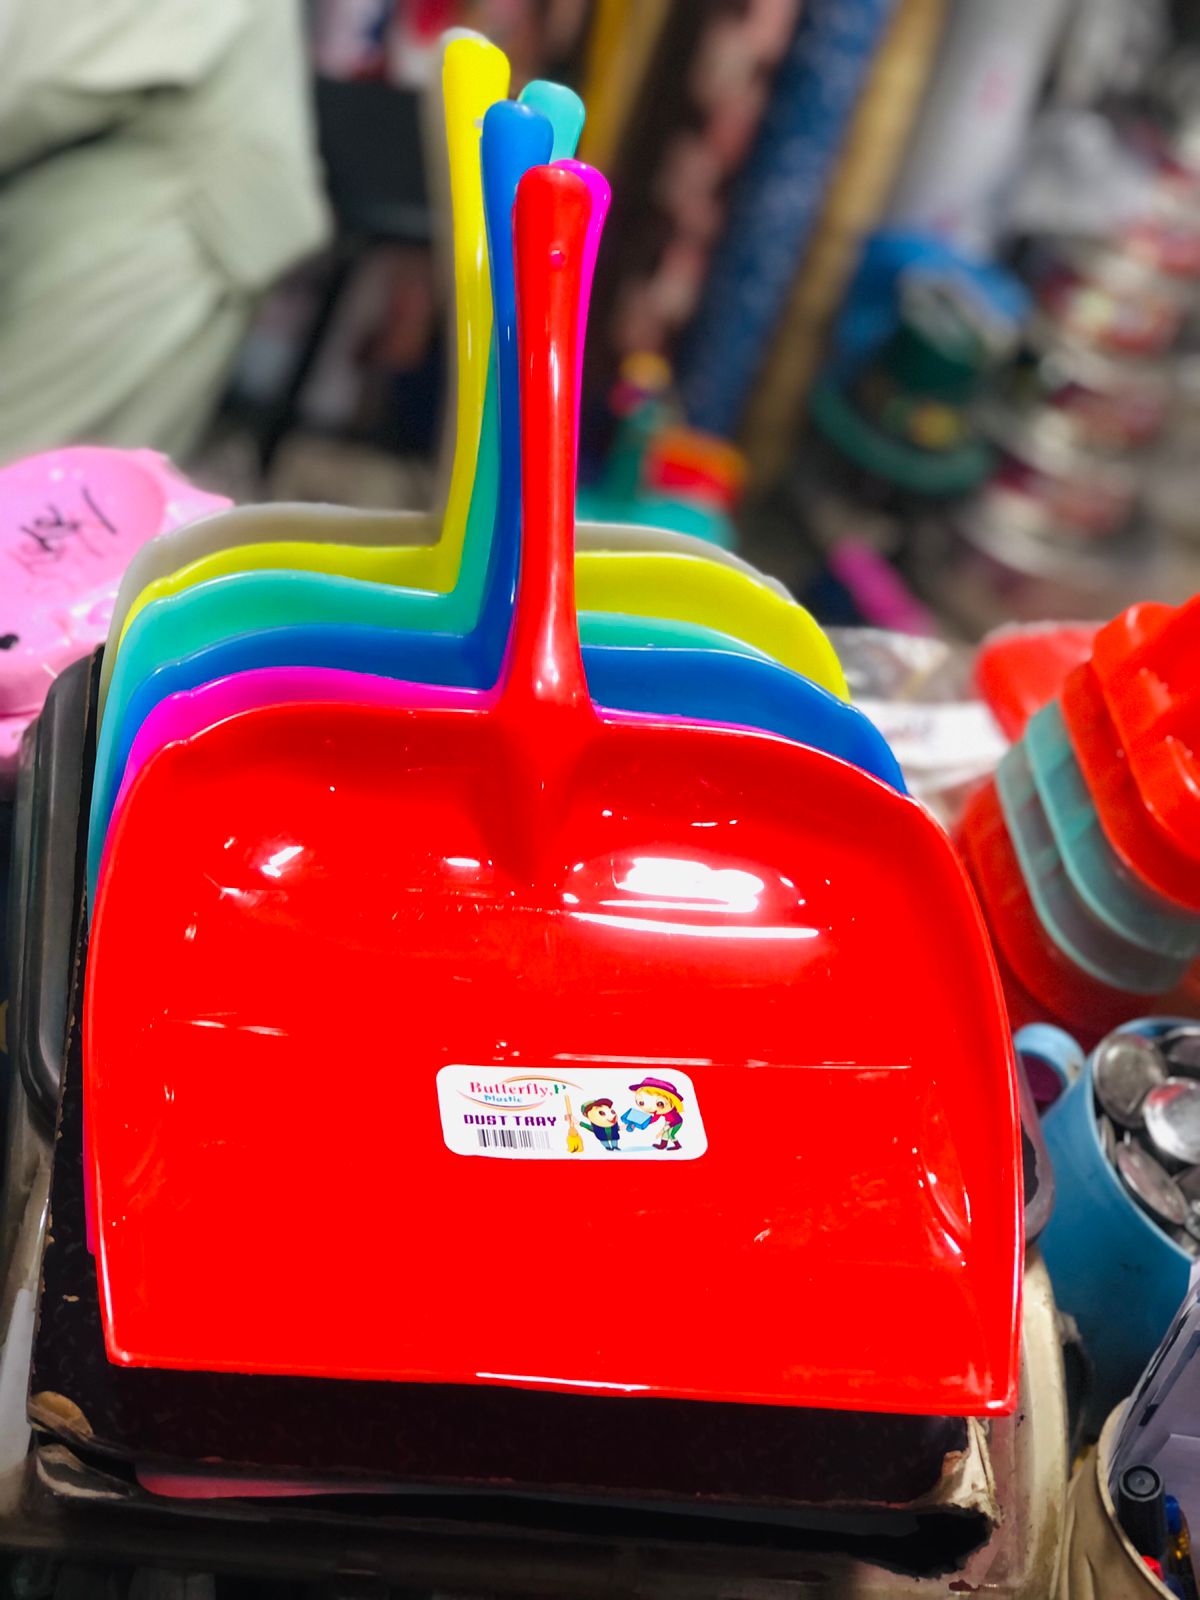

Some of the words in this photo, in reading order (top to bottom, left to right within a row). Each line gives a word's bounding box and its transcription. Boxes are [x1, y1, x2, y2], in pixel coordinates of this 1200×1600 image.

[484, 1094, 522, 1103] Plastic
[463, 1114, 507, 1126] DUST
[512, 1115, 557, 1127] TRAY
